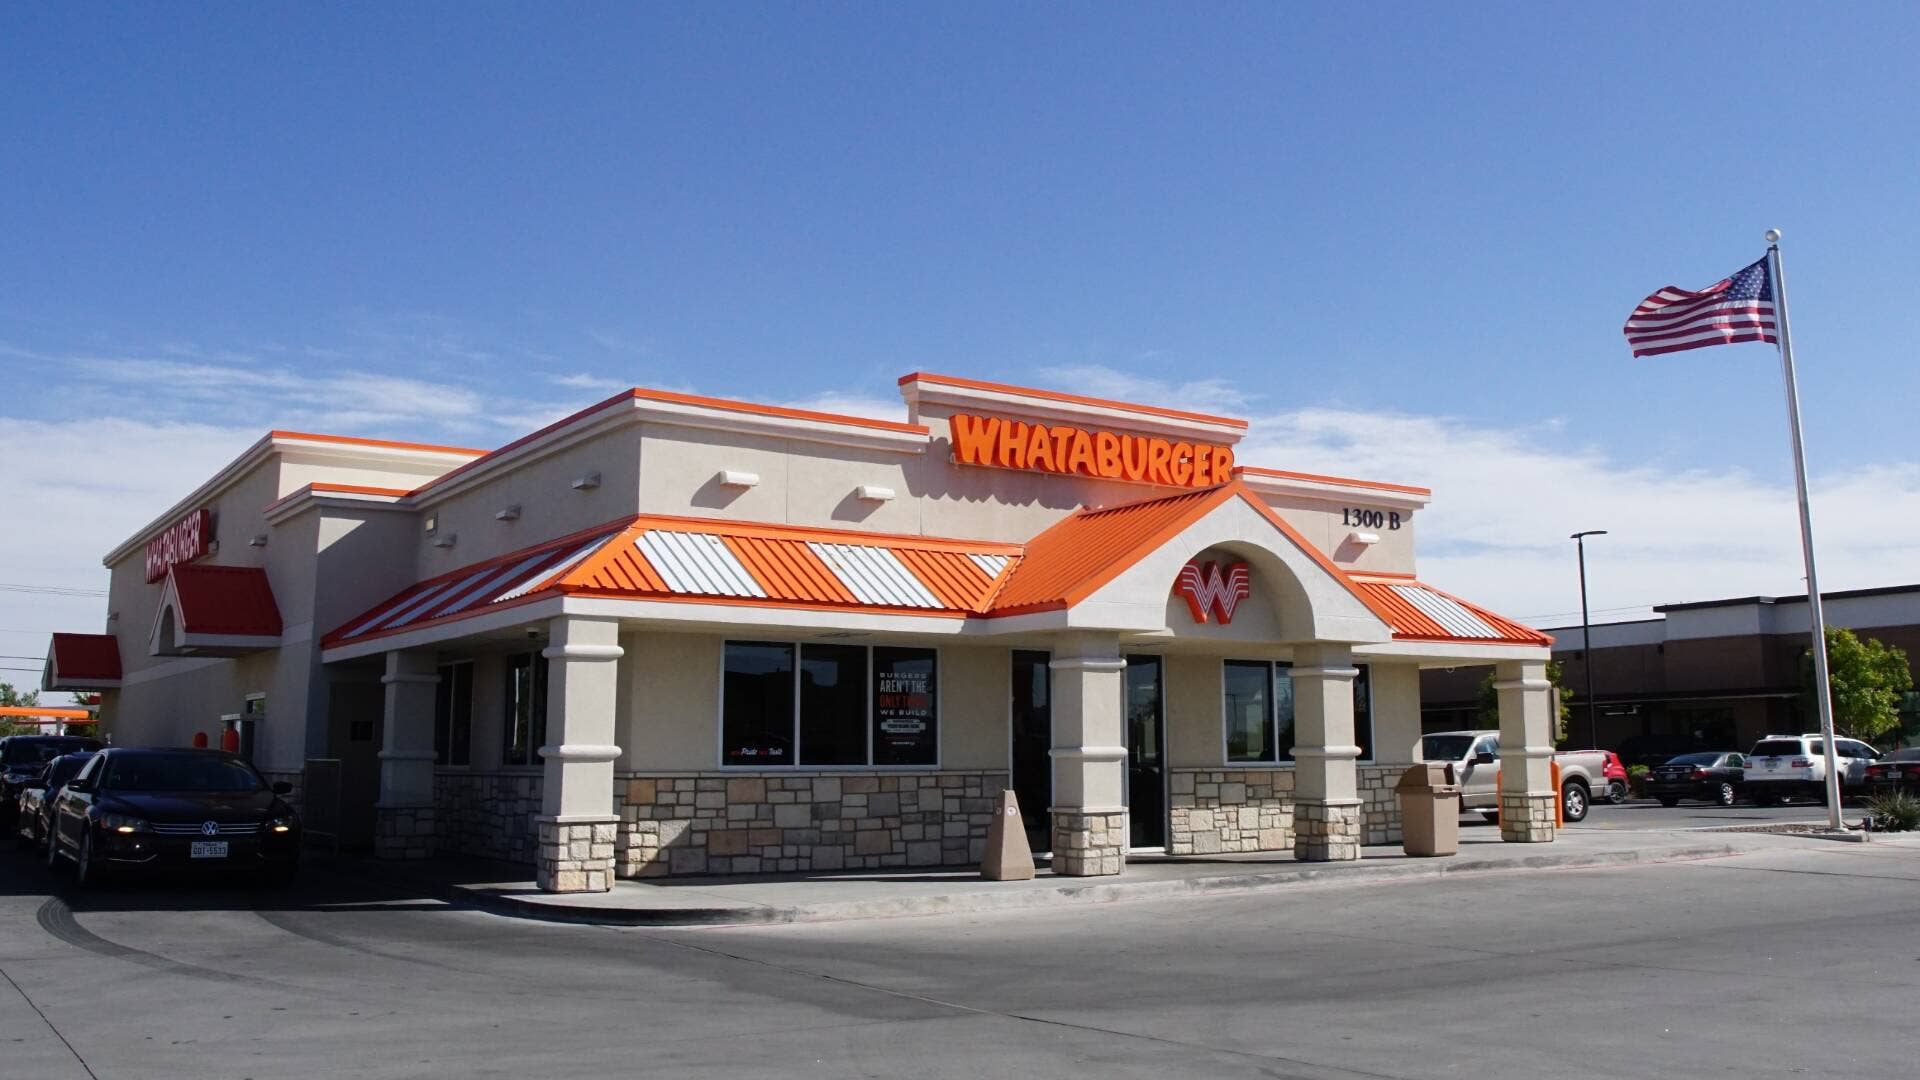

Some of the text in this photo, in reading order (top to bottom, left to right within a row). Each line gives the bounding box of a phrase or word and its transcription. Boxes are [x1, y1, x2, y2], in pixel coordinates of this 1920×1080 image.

[950, 414, 1234, 488] WHATABURGER
[1342, 507, 1401, 530] 1300 B
[146, 510, 201, 583] WHATABURGER
[879, 679, 927, 694] AREN'T THE
[898, 709, 927, 717] BUILD
